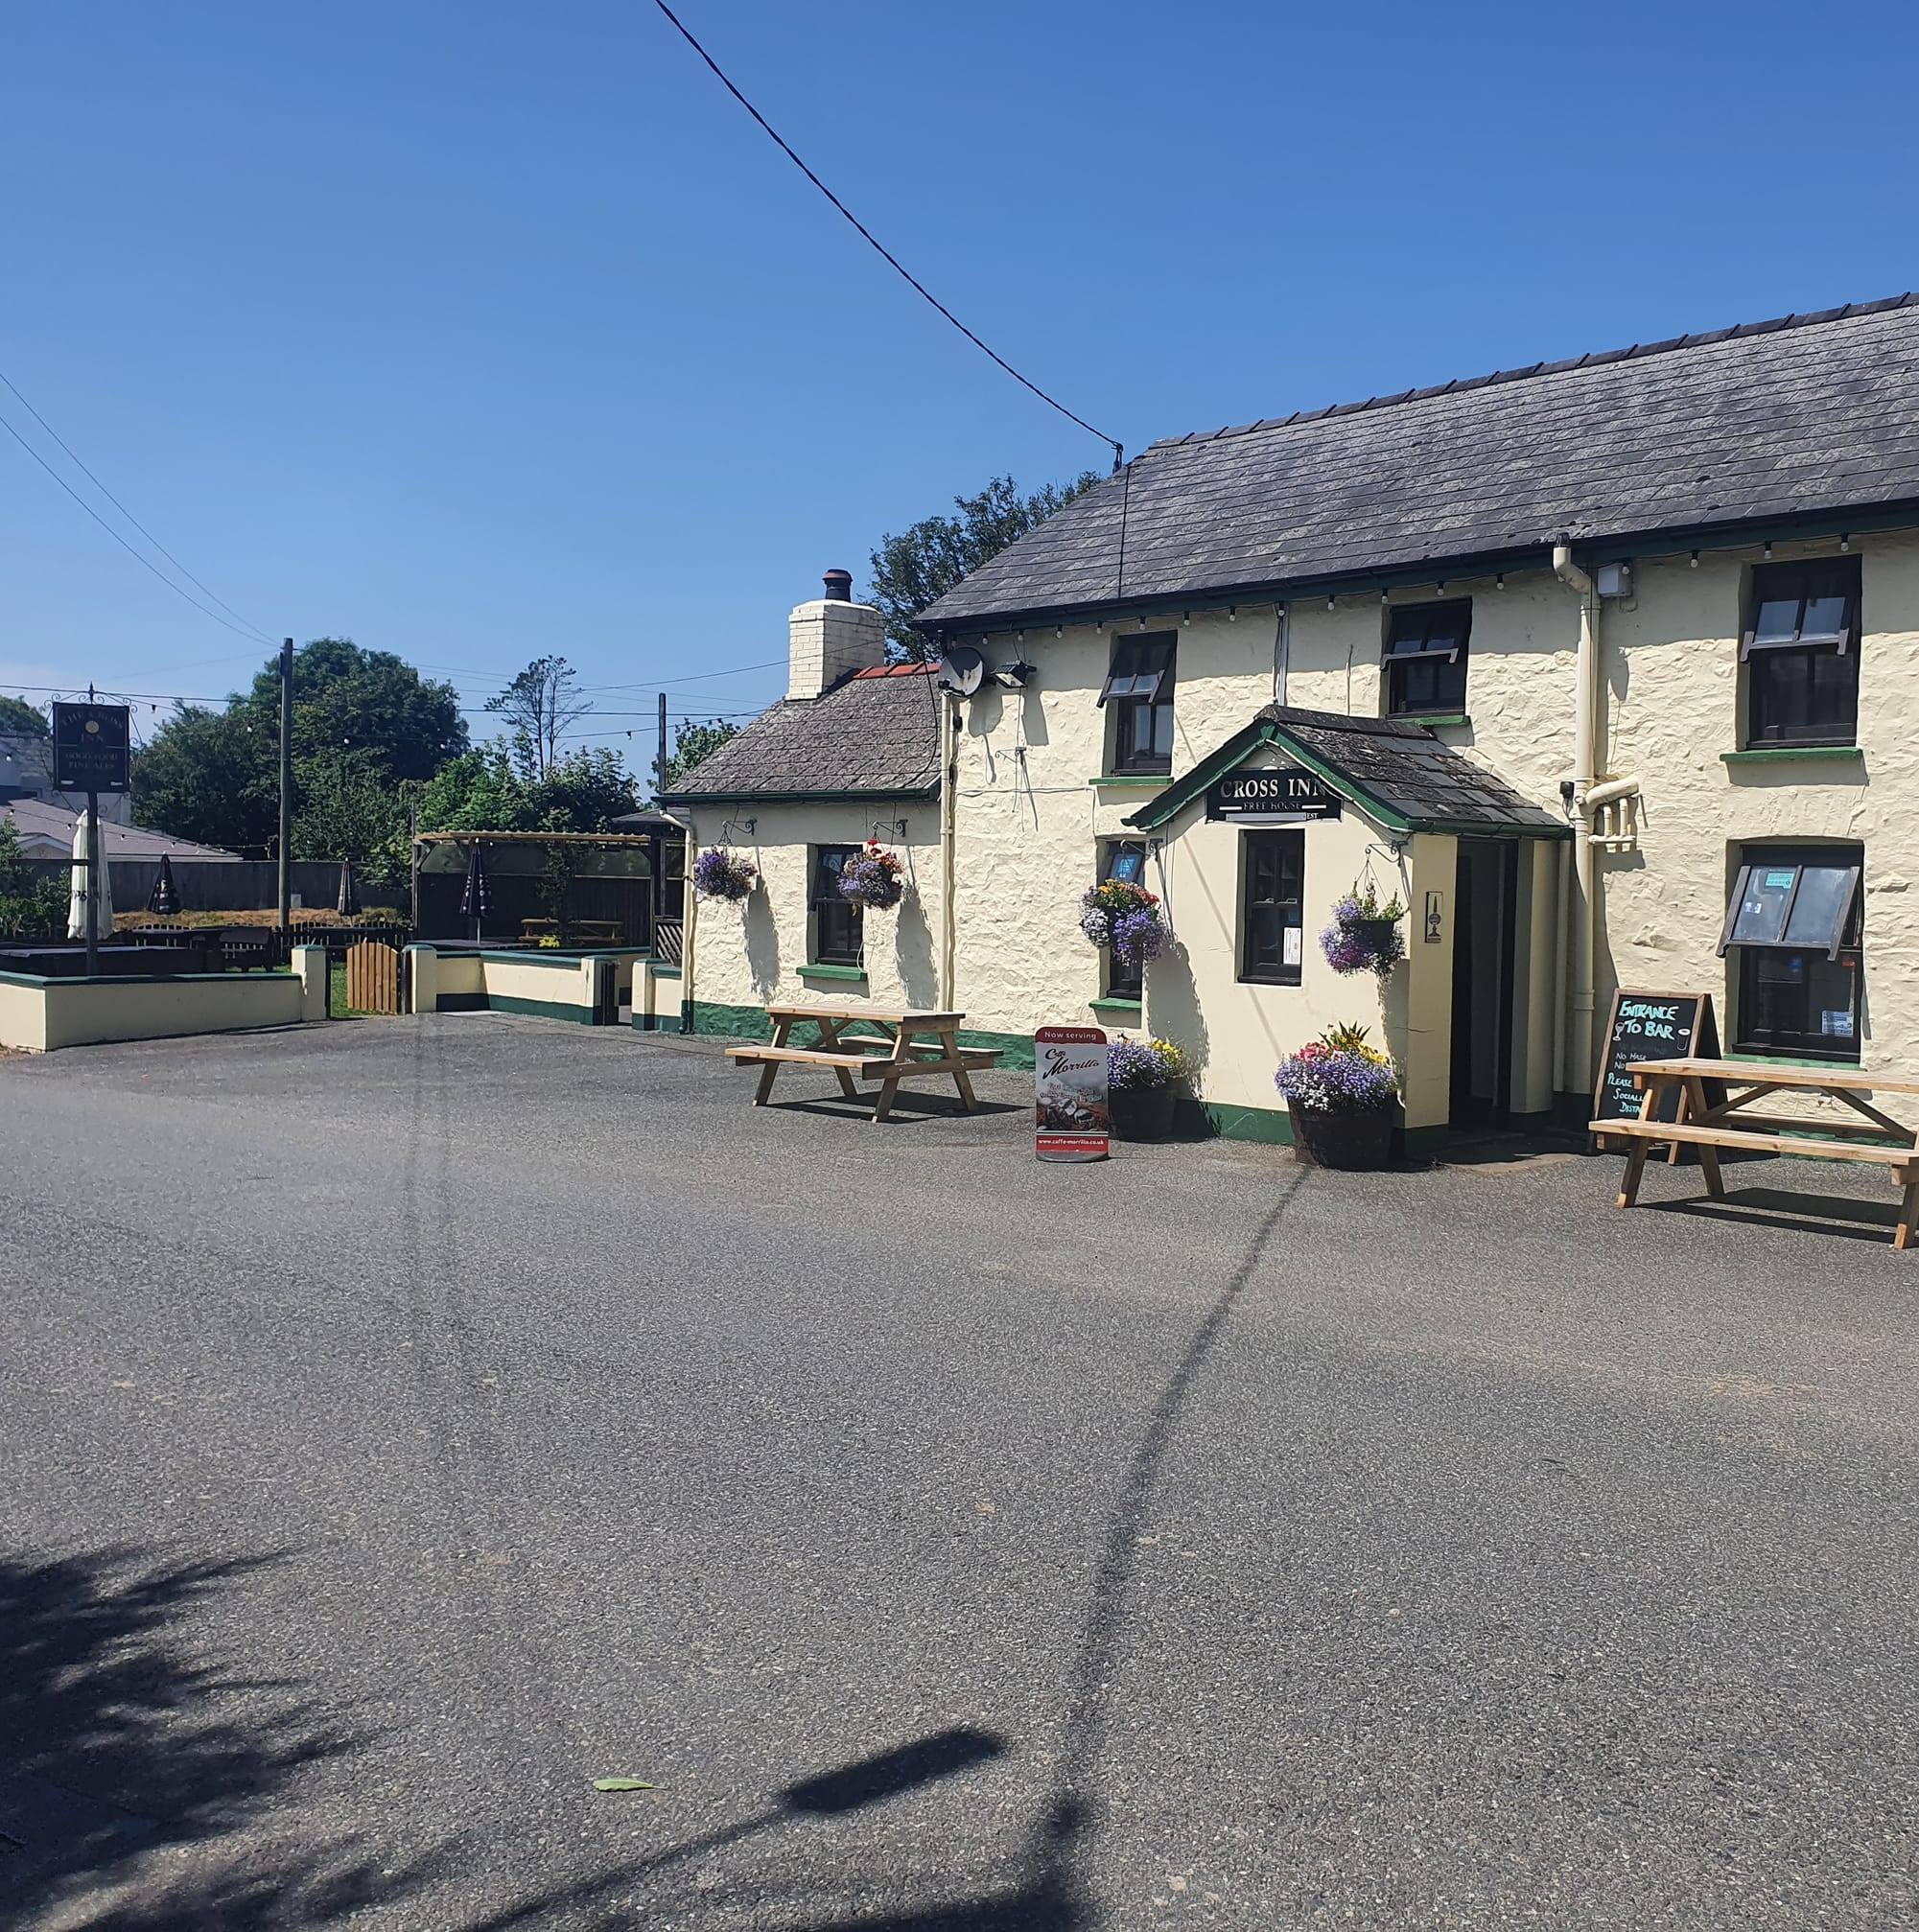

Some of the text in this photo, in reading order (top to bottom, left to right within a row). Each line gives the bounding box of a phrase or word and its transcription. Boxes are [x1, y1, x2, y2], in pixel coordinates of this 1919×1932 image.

[1220, 778, 1325, 799] CROSS INN
[1243, 801, 1301, 811] FREE HOUSE
[1618, 1000, 1680, 1021] ENTRANCE
[1065, 1032, 1097, 1041] serving
[1625, 1018, 1675, 1041] TO BAR
[1607, 1072, 1633, 1088] PLEASE
[1612, 1087, 1644, 1102] SOCIALL
